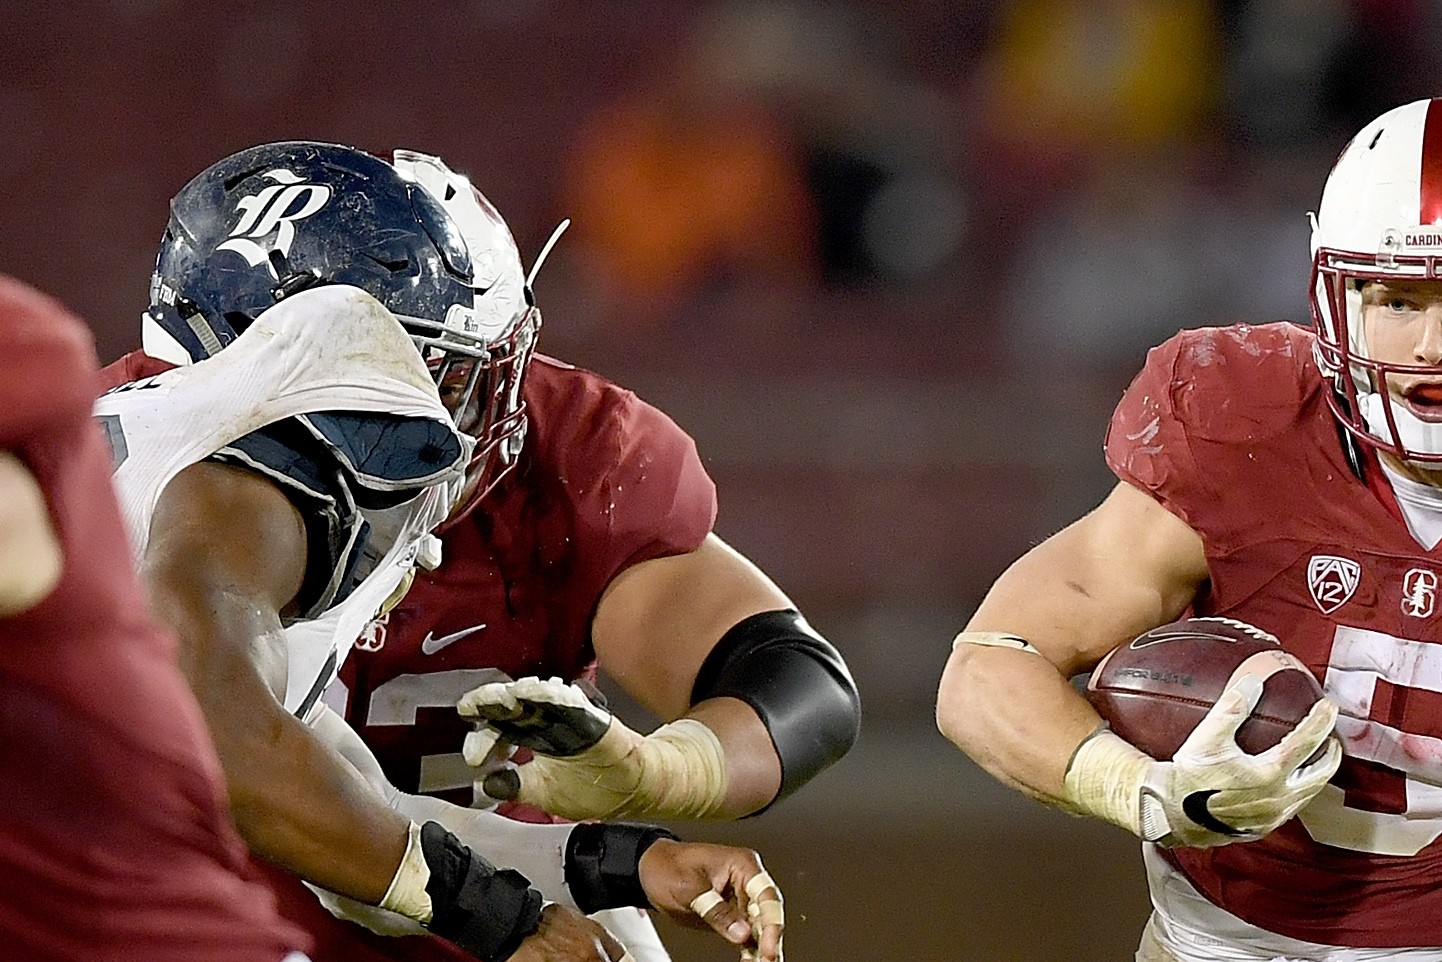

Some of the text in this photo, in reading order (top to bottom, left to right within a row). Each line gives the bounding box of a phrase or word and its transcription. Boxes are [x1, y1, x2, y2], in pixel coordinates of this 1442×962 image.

[216, 168, 333, 281] R
[1312, 558, 1357, 591] PAC
[1318, 581, 1343, 604] 12
